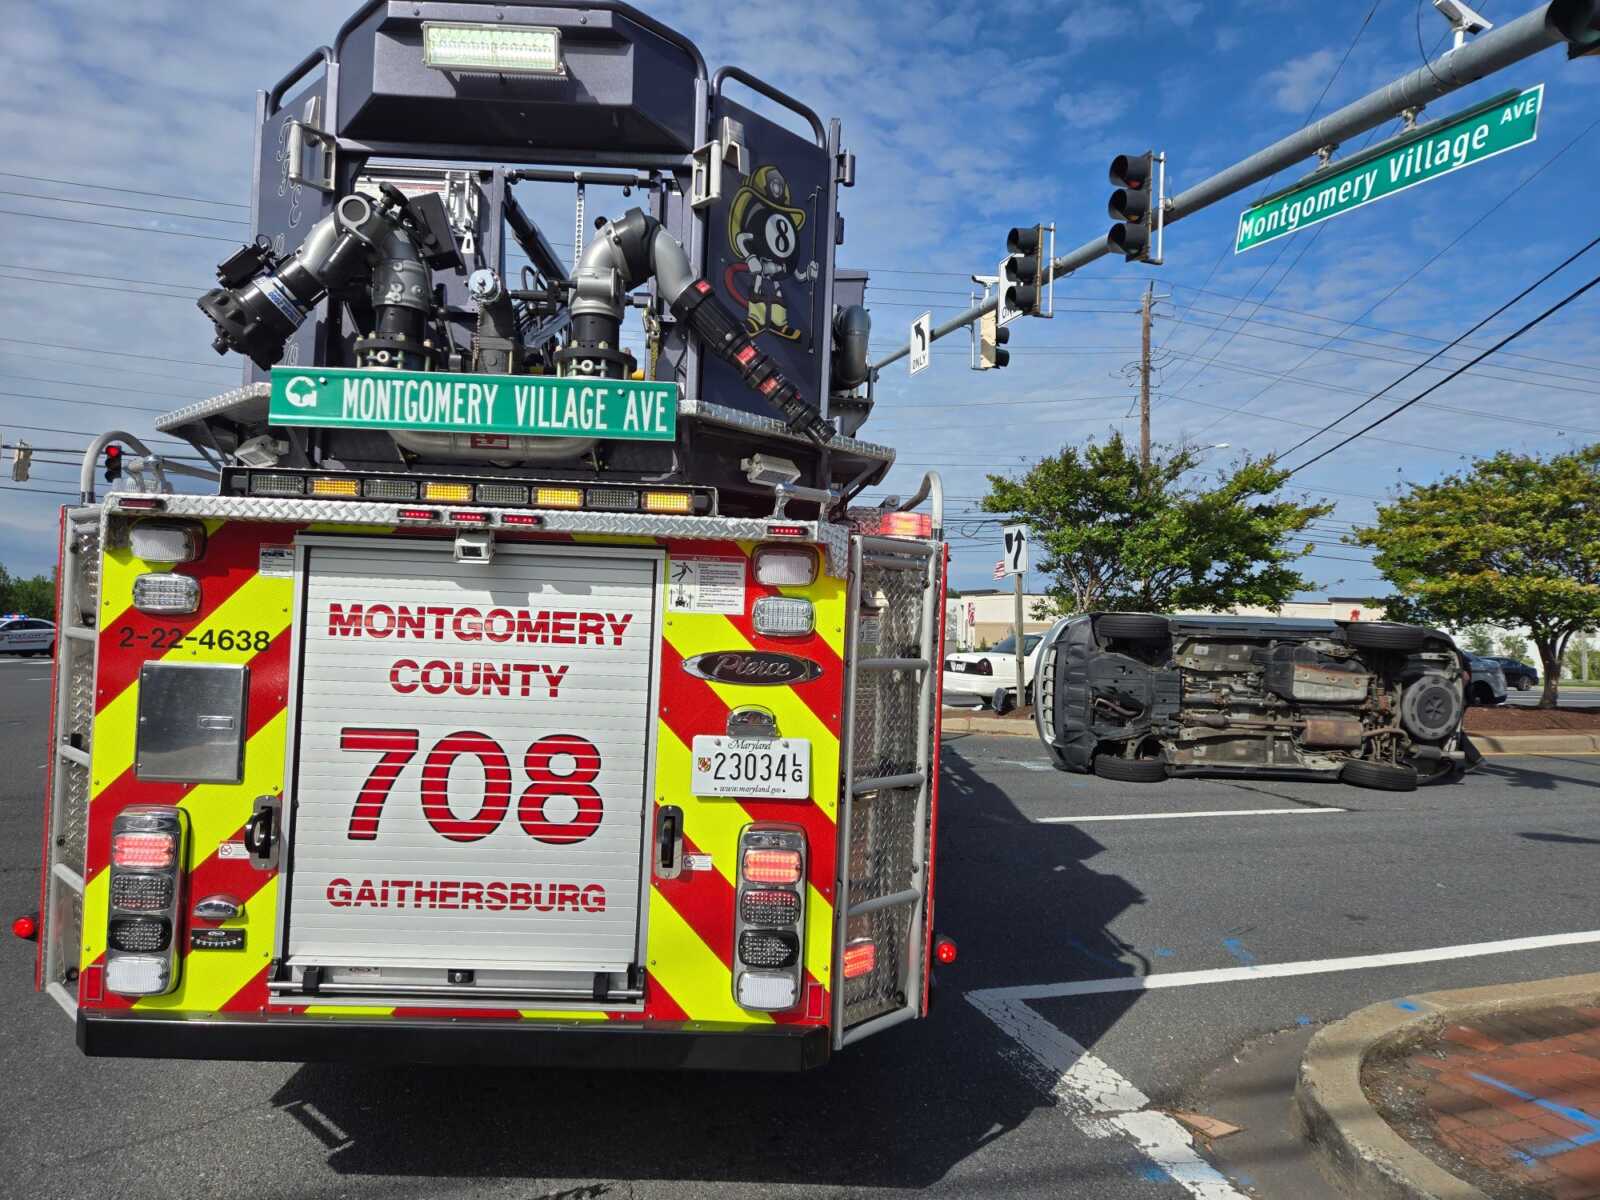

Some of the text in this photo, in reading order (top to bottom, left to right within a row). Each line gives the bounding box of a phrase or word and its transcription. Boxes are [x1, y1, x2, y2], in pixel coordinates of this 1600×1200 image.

[1239, 96, 1537, 243] Montgomery Village AVE
[775, 218, 790, 253] 8
[912, 354, 927, 370] ONLY
[341, 377, 668, 432] MONTGOMERY VILLAGE AVE
[119, 626, 271, 652] 2-22-4638
[328, 603, 633, 646] MONTGOMERY
[390, 658, 568, 698] COUNTY
[711, 653, 792, 677] Pierce
[728, 739, 773, 752] Maryland
[713, 752, 787, 782] 23034
[339, 726, 605, 845] 708
[326, 878, 606, 913] GAITHERSBURG
